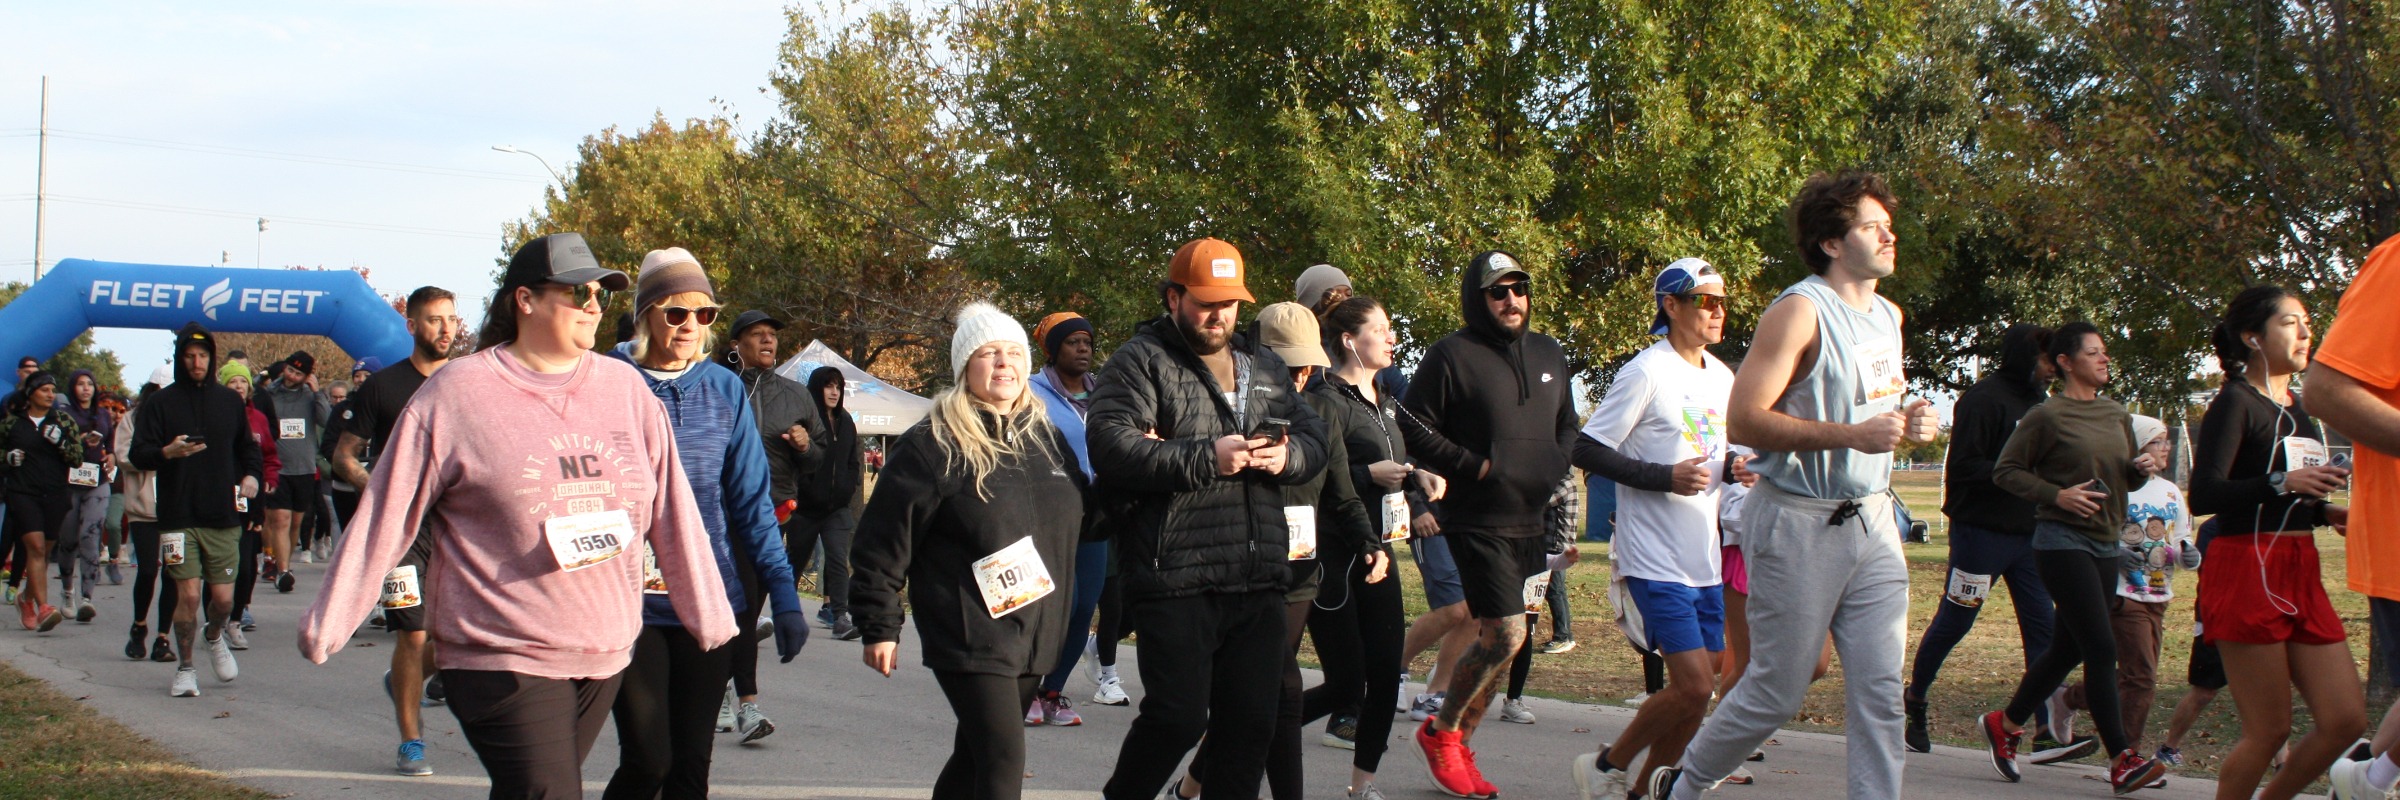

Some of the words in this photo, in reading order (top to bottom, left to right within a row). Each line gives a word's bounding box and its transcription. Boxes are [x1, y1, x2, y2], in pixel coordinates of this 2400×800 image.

[89, 280, 195, 309] FLEET
[239, 288, 323, 314] FEET
[862, 415, 894, 426] FEET
[548, 433, 633, 476] MITCHELL
[558, 454, 602, 480] NC
[560, 482, 610, 495] ORIGINAL
[571, 500, 600, 514] 6684
[570, 533, 619, 553] 1550
[996, 561, 1034, 590] 1970
[384, 581, 406, 595] 1620
[1961, 584, 1977, 595] 181
